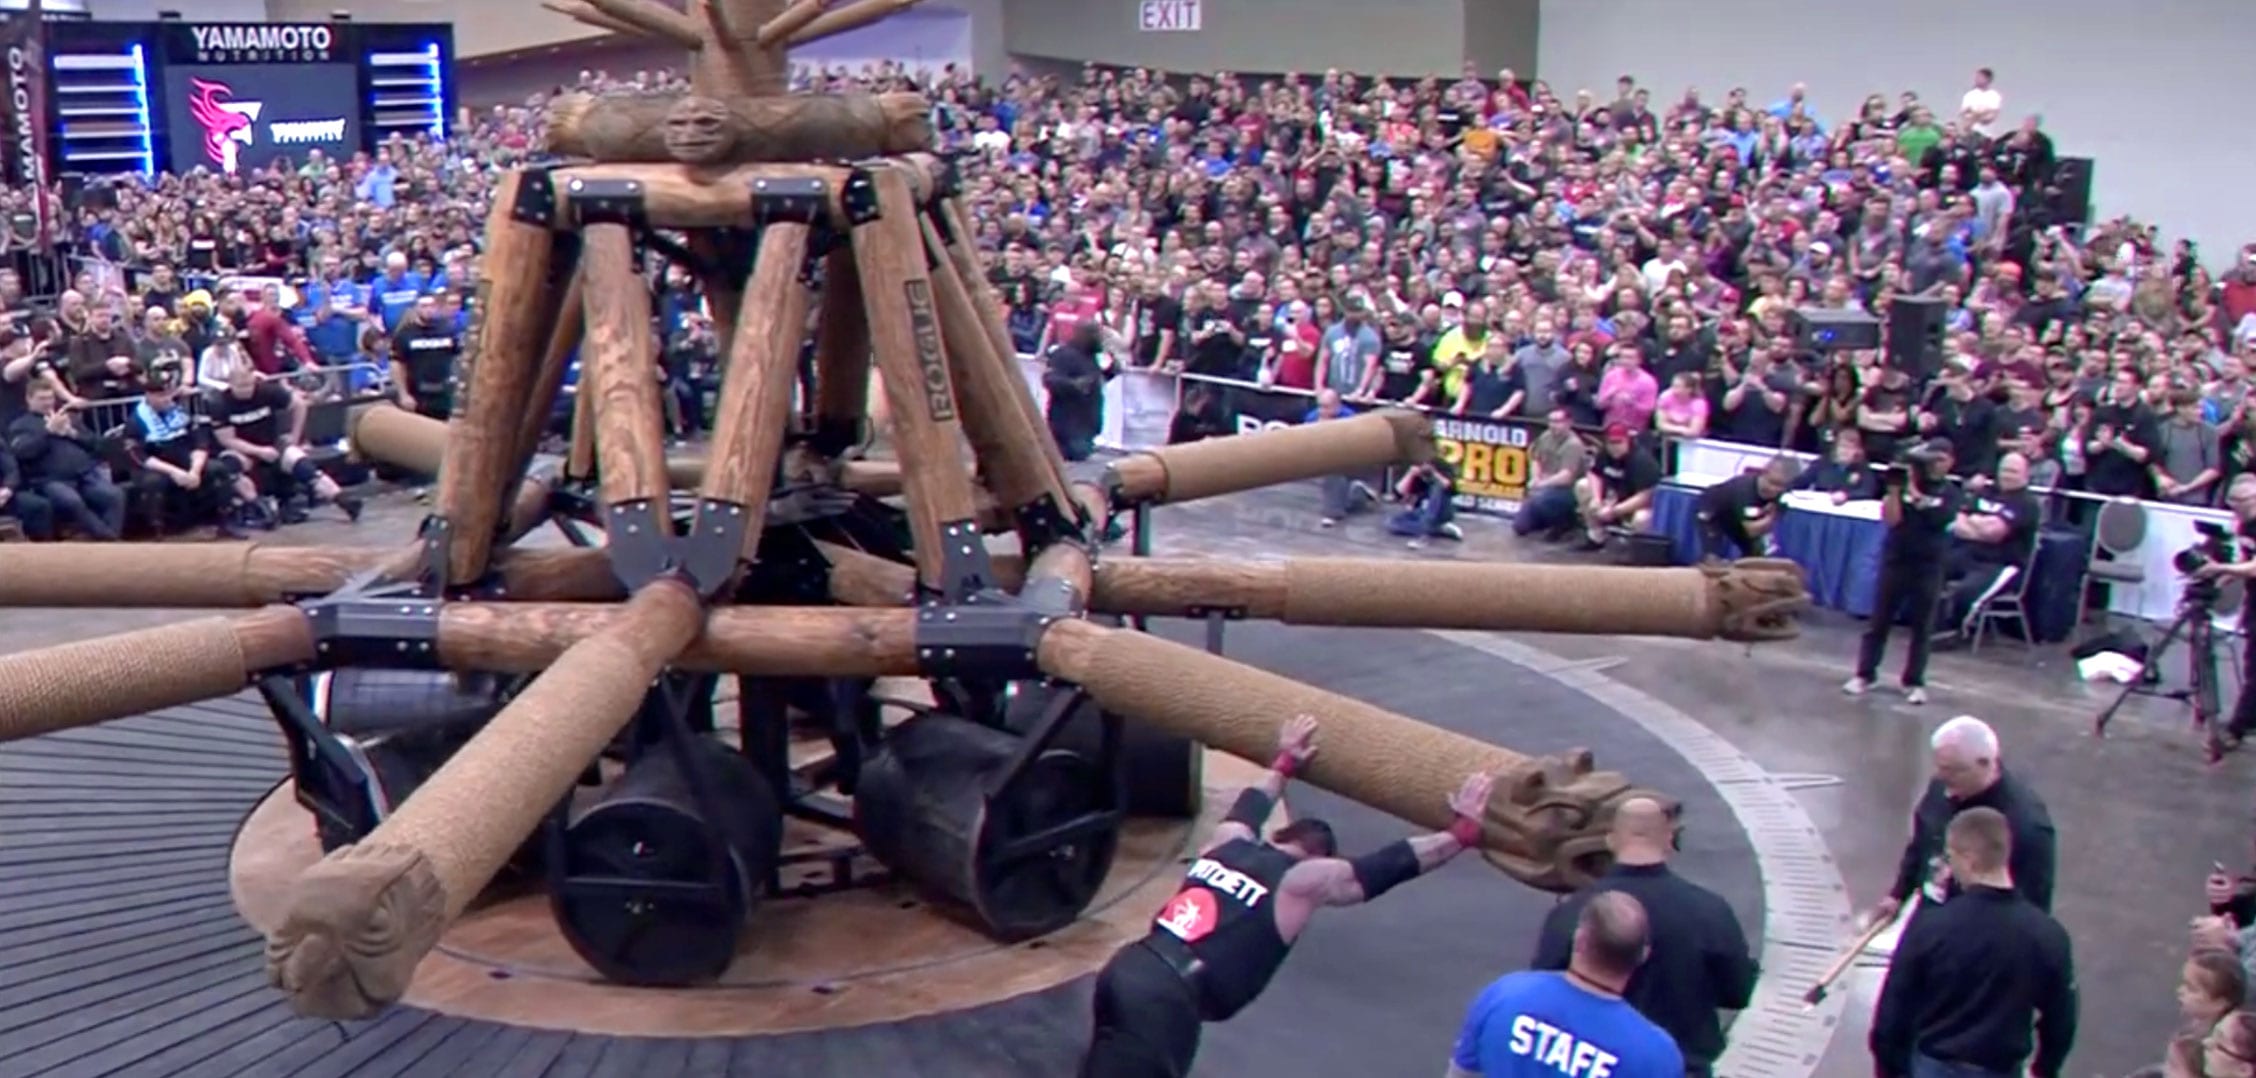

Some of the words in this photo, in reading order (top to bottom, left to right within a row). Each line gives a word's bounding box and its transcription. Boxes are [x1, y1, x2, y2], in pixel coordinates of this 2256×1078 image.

[1143, 2, 1197, 27] EXIT
[191, 26, 331, 49] YAMAMOTO
[198, 50, 329, 61] NUTRITION
[8, 47, 37, 196] MAMOTO
[906, 282, 953, 418] ROGUE
[1434, 419, 1528, 447] ARNOLD
[1437, 439, 1527, 485] PRO
[1509, 1014, 1619, 1078] STAFF
